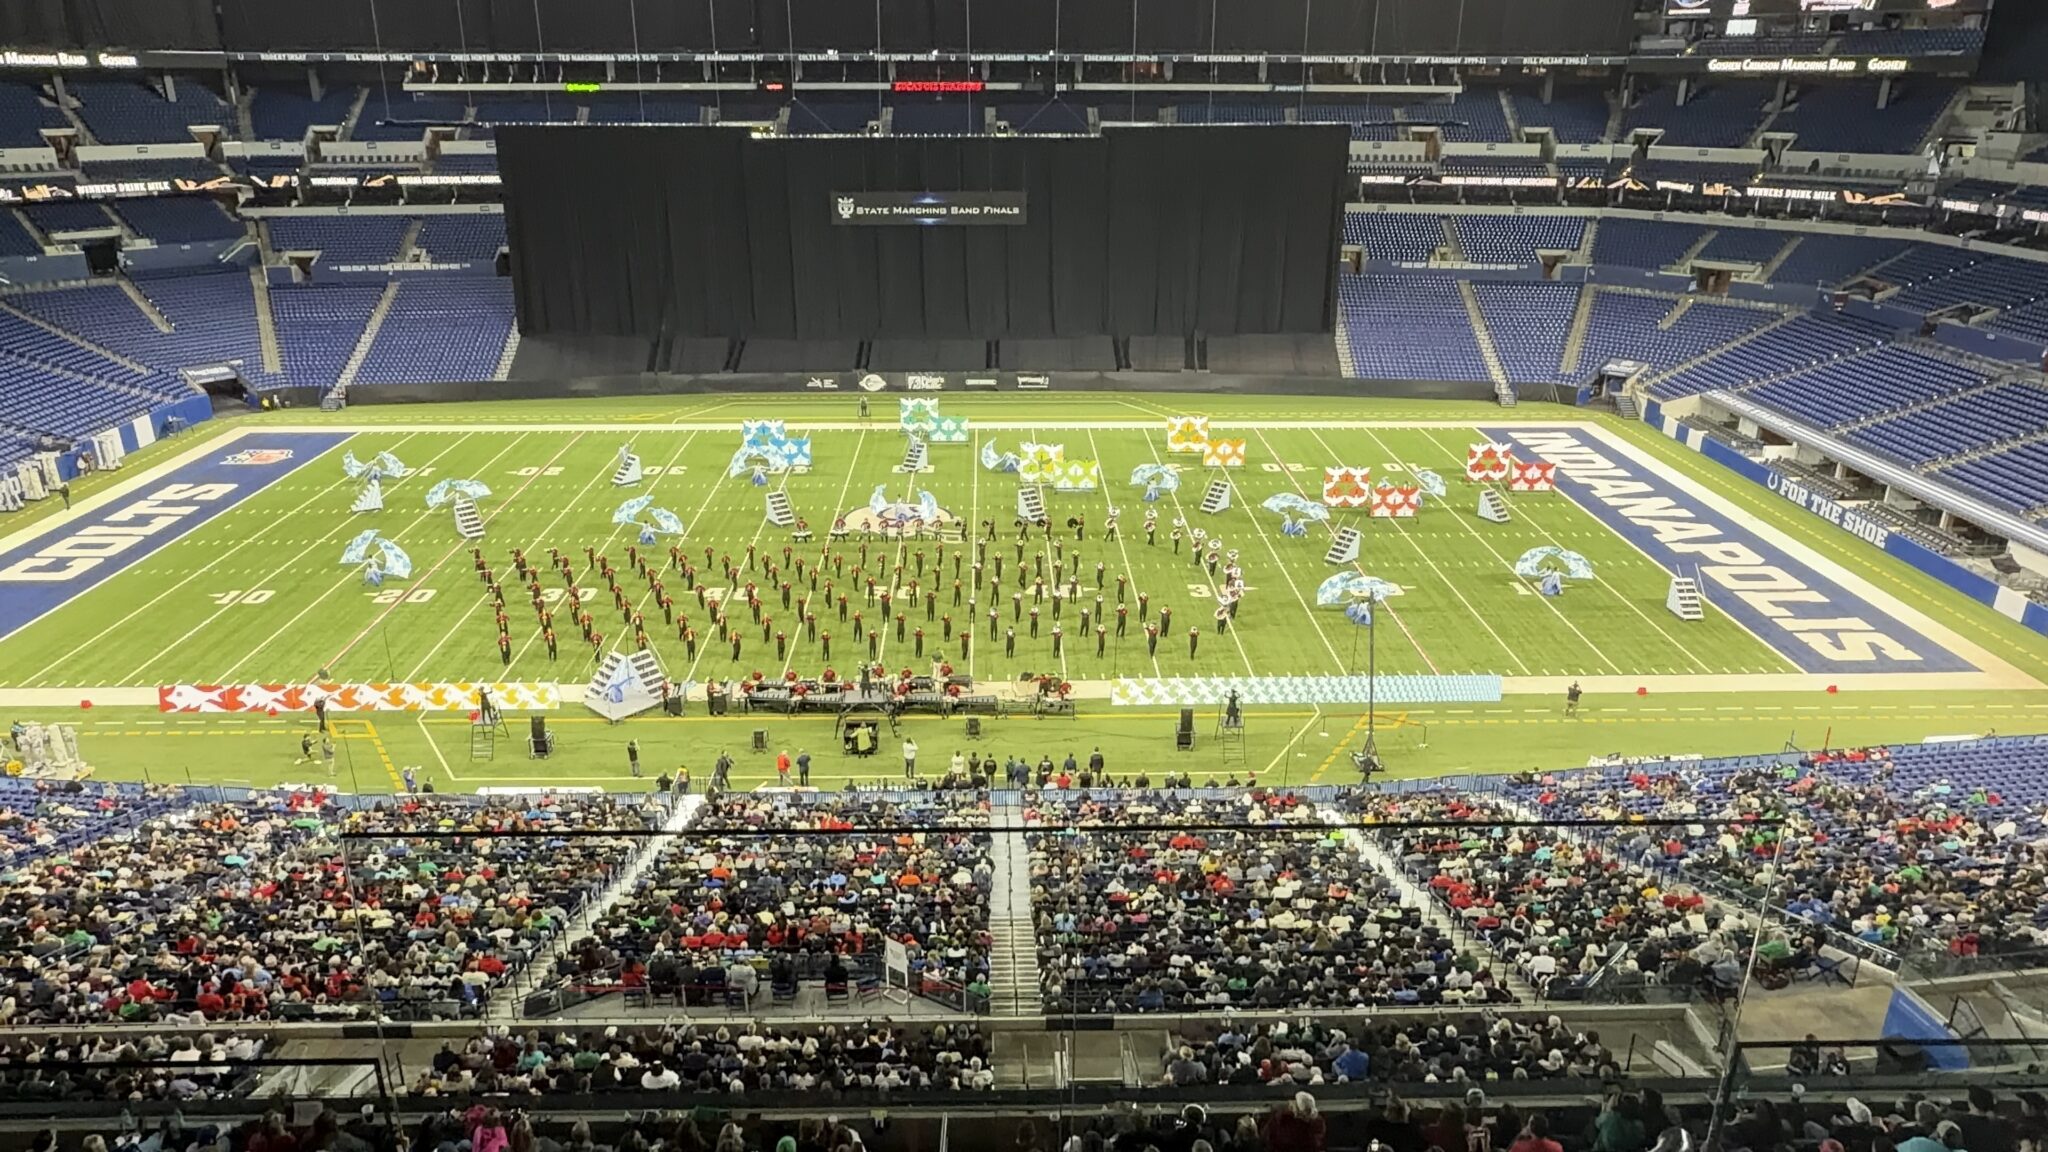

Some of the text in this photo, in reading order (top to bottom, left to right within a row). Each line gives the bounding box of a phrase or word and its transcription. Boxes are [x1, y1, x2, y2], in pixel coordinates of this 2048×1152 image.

[4, 52, 136, 66] MARCHING BAND GOSHEN
[1708, 58, 1907, 71] GOSHEN CRIMSON MARCHING BAND GOSHEN
[76, 183, 116, 195] WINNERS
[118, 182, 146, 193] DRINK
[148, 181, 171, 192] MILK
[1747, 186, 1783, 198] WINNERS
[1784, 188, 1812, 199] DRINK
[1812, 190, 1837, 200] MILK
[856, 206, 1020, 215] STATE MARCHING BAND FINALS
[1779, 478, 1888, 549] FOR THE SHOE
[0, 483, 238, 581] COLTS
[1508, 431, 1924, 661] INDIANAPOLIS
[215, 589, 276, 604] 10
[371, 588, 437, 603] 20
[541, 588, 598, 602] 30
